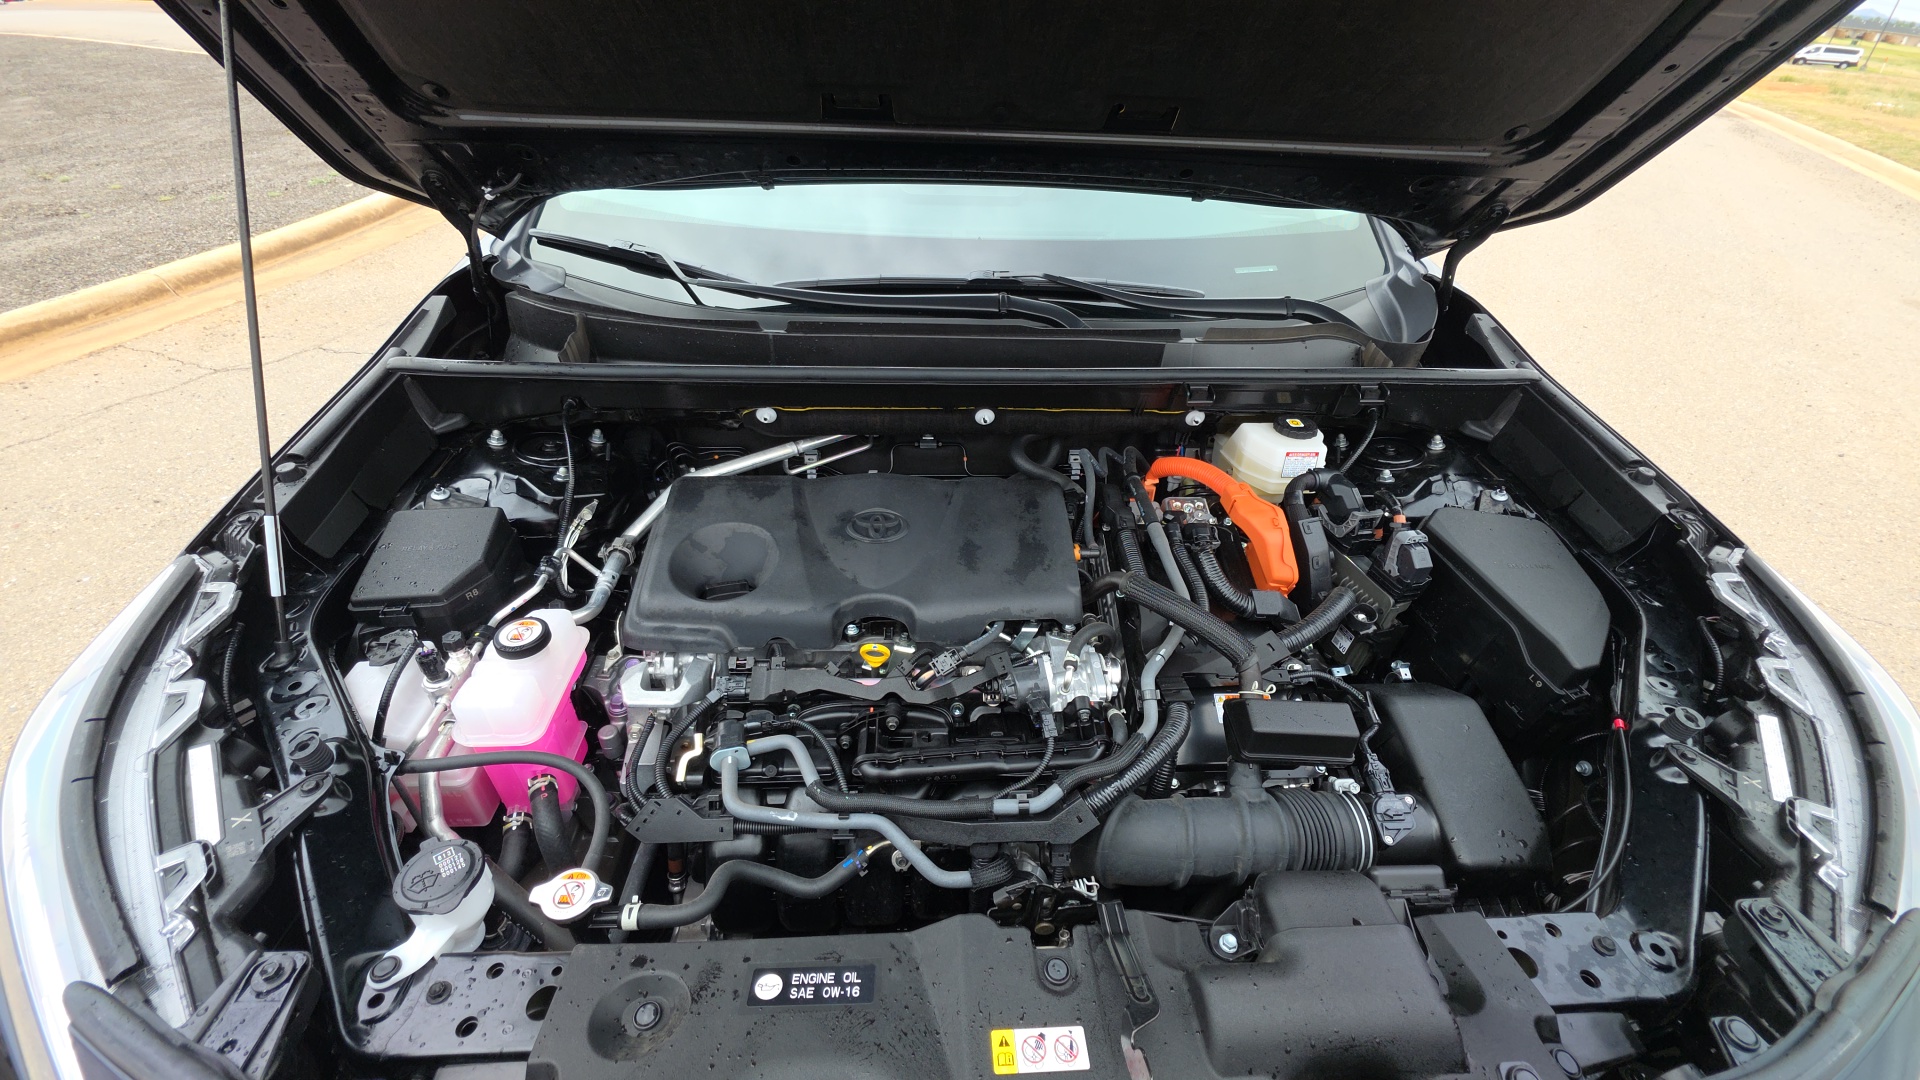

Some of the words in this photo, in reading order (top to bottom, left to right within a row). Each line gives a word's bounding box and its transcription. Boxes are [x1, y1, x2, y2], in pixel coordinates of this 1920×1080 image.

[465, 588, 479, 600] R8
[792, 973, 836, 985] ENGINE
[843, 972, 862, 983] OIL
[789, 987, 815, 999] SAE
[822, 985, 861, 999] 0W-16
